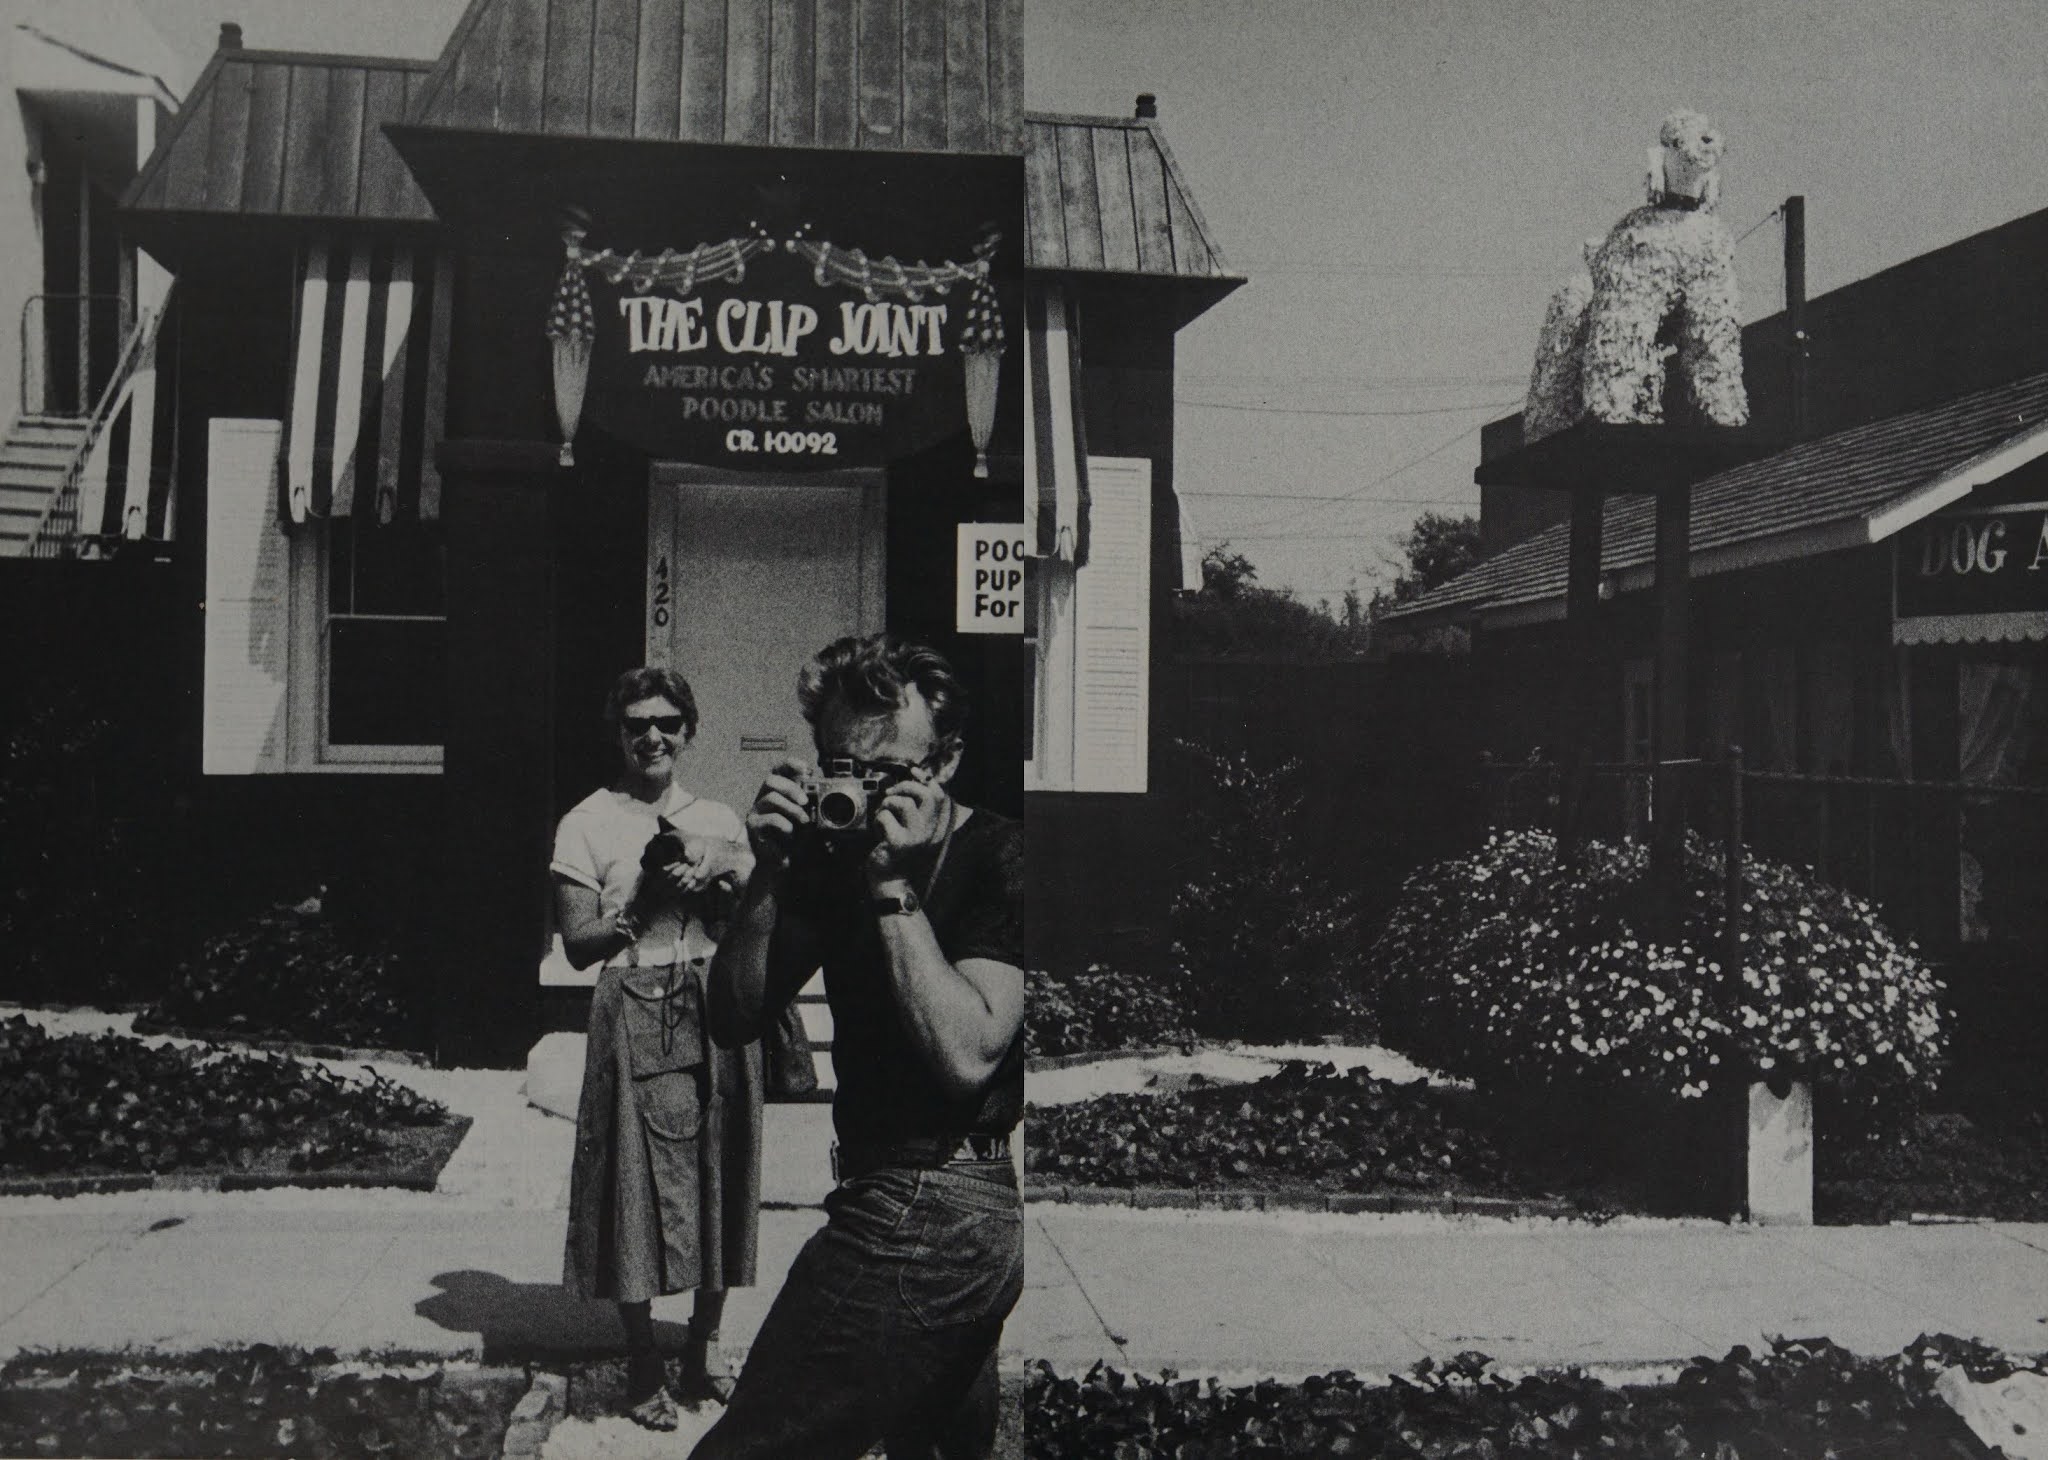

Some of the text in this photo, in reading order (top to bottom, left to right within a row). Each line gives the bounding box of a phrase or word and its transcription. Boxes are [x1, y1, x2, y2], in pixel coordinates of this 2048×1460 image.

[619, 296, 947, 358] THE CLIP JOINT
[644, 363, 916, 395] AMERICA'S SMARTEST
[682, 396, 884, 425] POODLE SALON
[726, 429, 759, 452] CR.
[1921, 519, 2008, 577] DOG
[654, 556, 670, 627] 420
[975, 569, 1022, 591] PUP
[974, 593, 1020, 618] For
